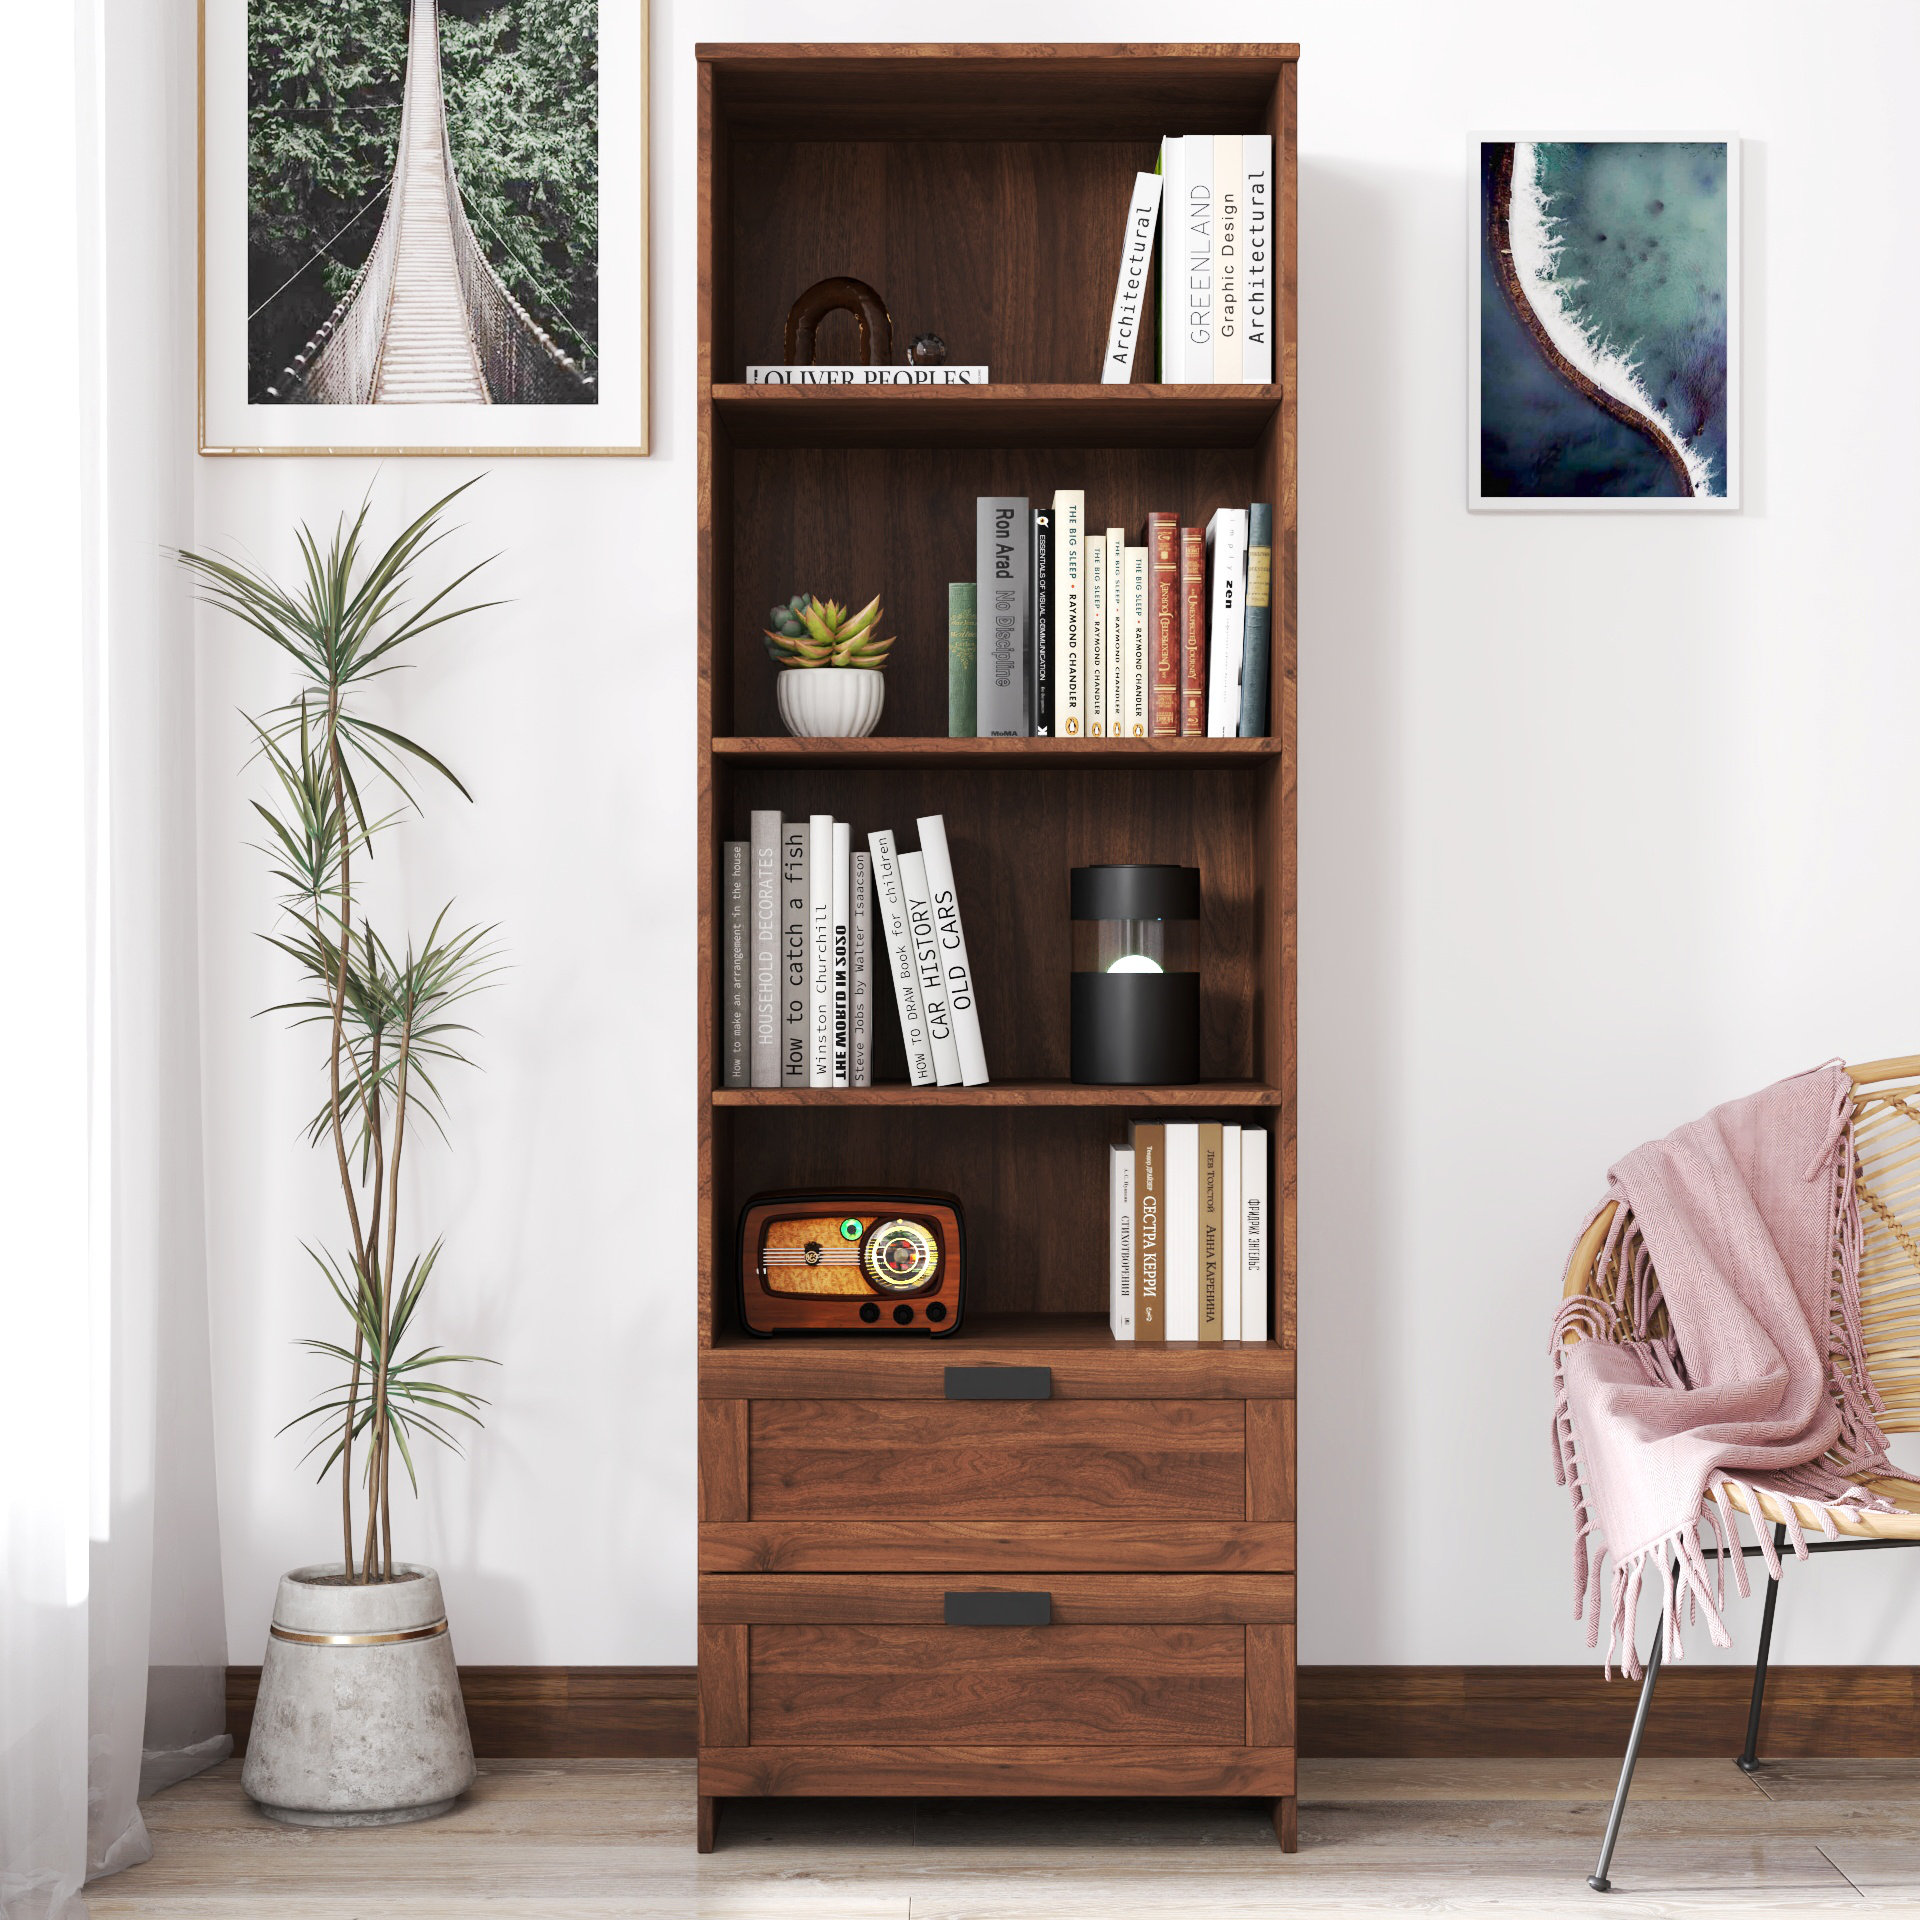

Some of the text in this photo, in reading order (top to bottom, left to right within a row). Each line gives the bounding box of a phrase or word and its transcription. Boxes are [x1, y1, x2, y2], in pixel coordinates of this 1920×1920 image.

[1112, 206, 1152, 365] Architectural
[1190, 184, 1211, 344] GREENLAND
[1221, 193, 1238, 338] Graphic Design
[1248, 170, 1265, 344] Architectural
[995, 508, 1015, 579] Ron Arad
[1039, 579, 1046, 590] OF
[1069, 505, 1077, 579] THE BIG SLEEP
[1158, 581, 1174, 618] JOURNEY
[1225, 580, 1233, 609] zen
[991, 590, 1015, 688] No Discipline
[1068, 594, 1077, 708] RAYMOND CHANDLER
[1158, 617, 1171, 672] UNEXPECTED
[1184, 645, 1198, 680] JOURNEY
[731, 846, 743, 1077] How to make an arrangement in the house
[758, 847, 774, 1044] HOUSEHOLD DECORATES
[784, 834, 803, 1076] How to catch a fish
[815, 904, 827, 1075] Winston Churchill
[854, 854, 867, 1081] Steve Jobs by Walter Isaacson
[879, 836, 928, 1079] HOW TO DRAW Book for children
[909, 899, 950, 1040] CAR HISTORY
[935, 890, 971, 1010] OLD CARS
[1121, 1215, 1130, 1296] СТИХОТВОРЕНИЯ
[1142, 1195, 1157, 1297] СЕСТРА КЕРРИ
[1247, 1198, 1261, 1271] ФРИДРИХ ЭНГЕЛЬС
